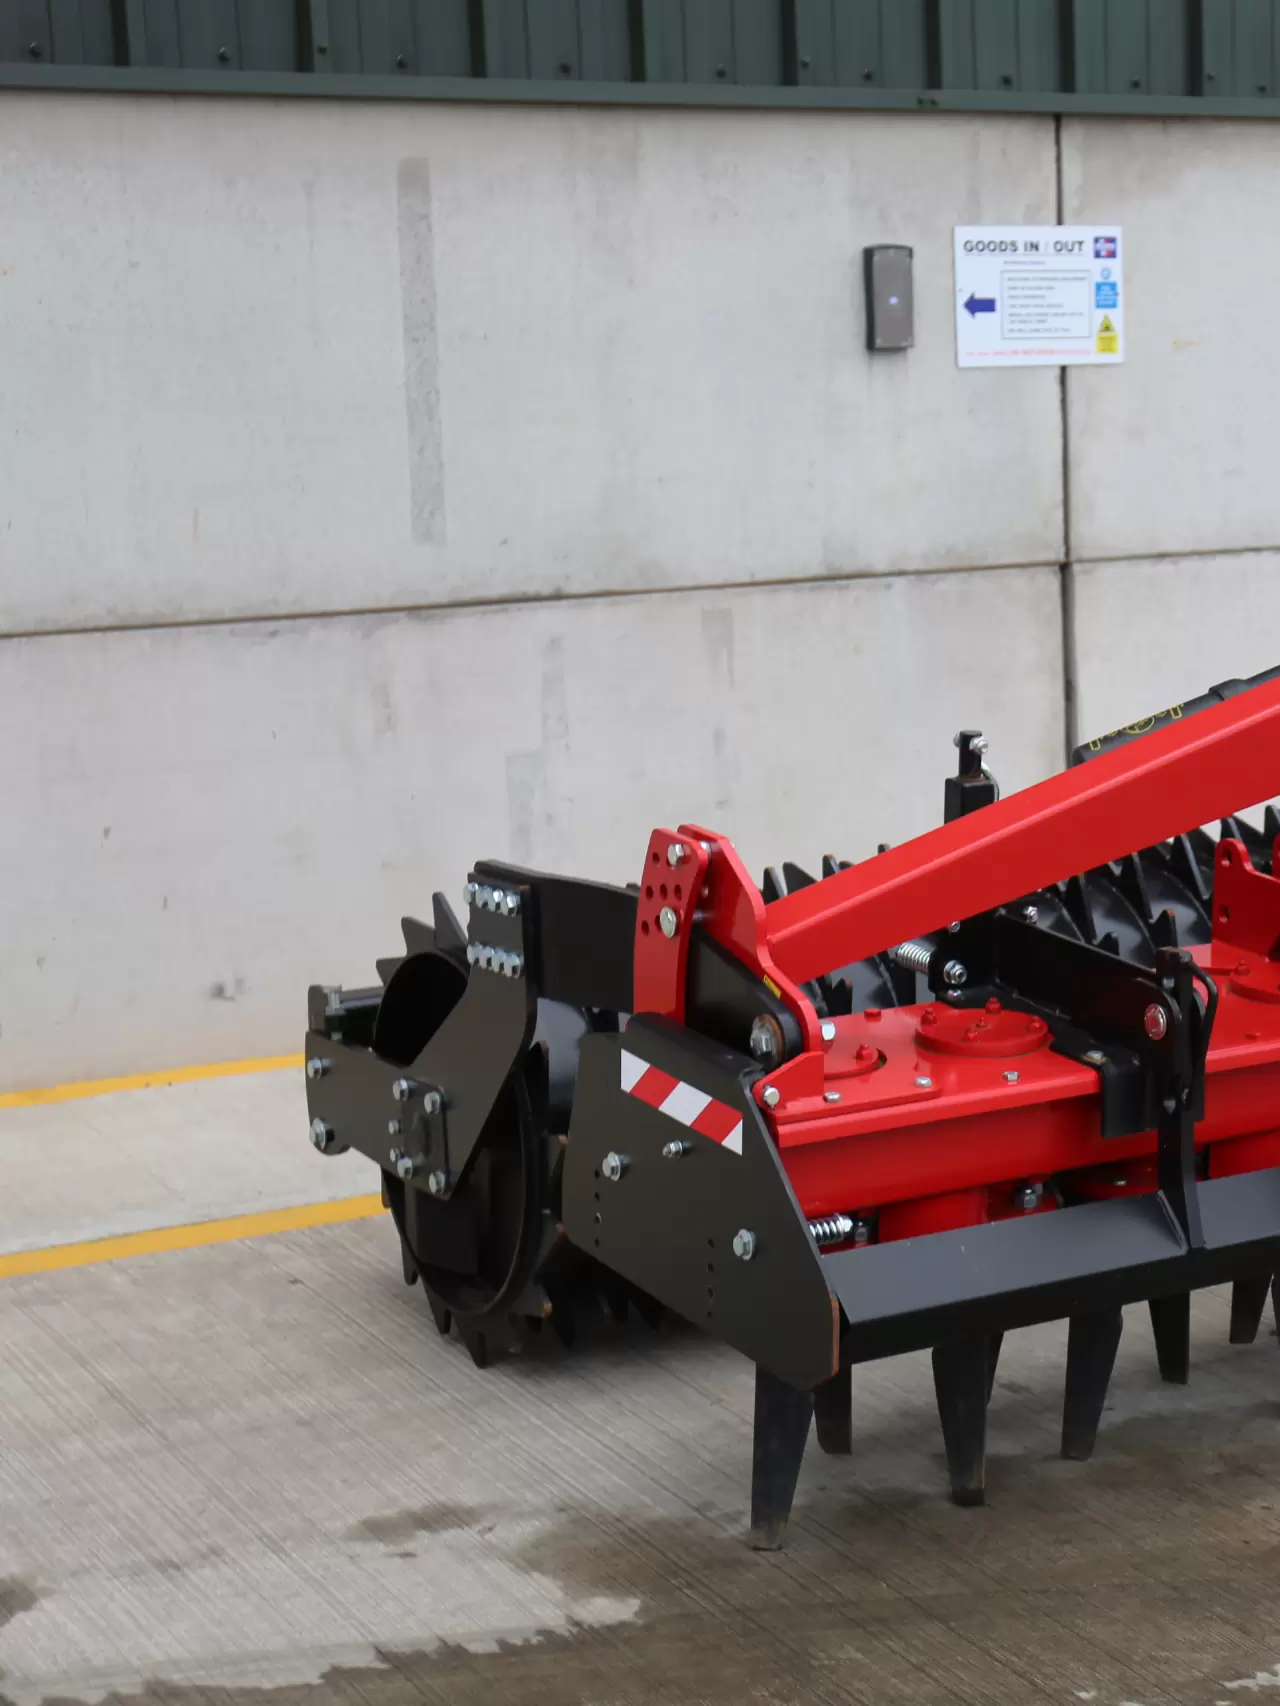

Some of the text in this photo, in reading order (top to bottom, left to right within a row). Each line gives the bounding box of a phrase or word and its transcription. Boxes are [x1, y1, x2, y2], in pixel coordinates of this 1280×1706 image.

[963, 239, 1019, 253] GOODS
[1024, 239, 1040, 253] IN
[1053, 239, 1085, 253] OUT
